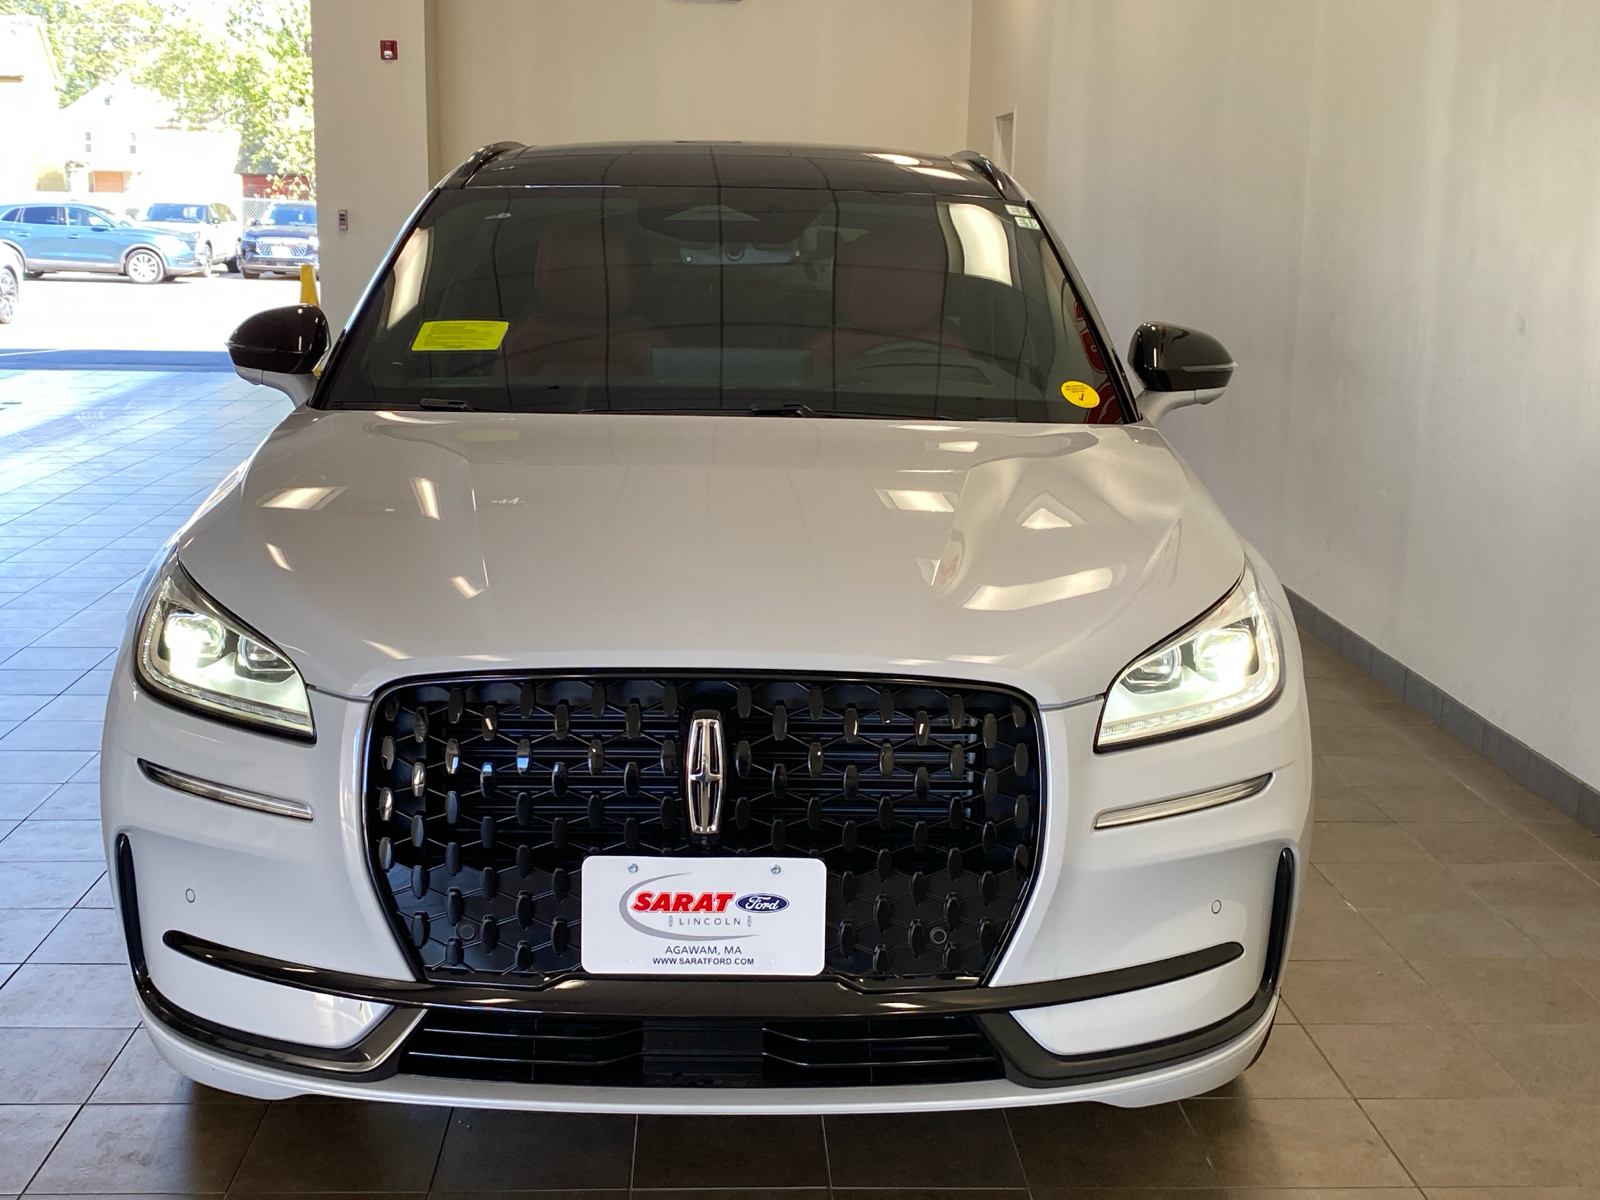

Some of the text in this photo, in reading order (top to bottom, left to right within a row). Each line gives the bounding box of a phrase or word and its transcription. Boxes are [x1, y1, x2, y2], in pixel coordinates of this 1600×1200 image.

[631, 891, 781, 914] SARAT Ford
[679, 918, 741, 926] LINCOLN
[665, 945, 743, 956] AGAWAM, MA
[652, 957, 755, 966] WWW.SARATFORD.COM
